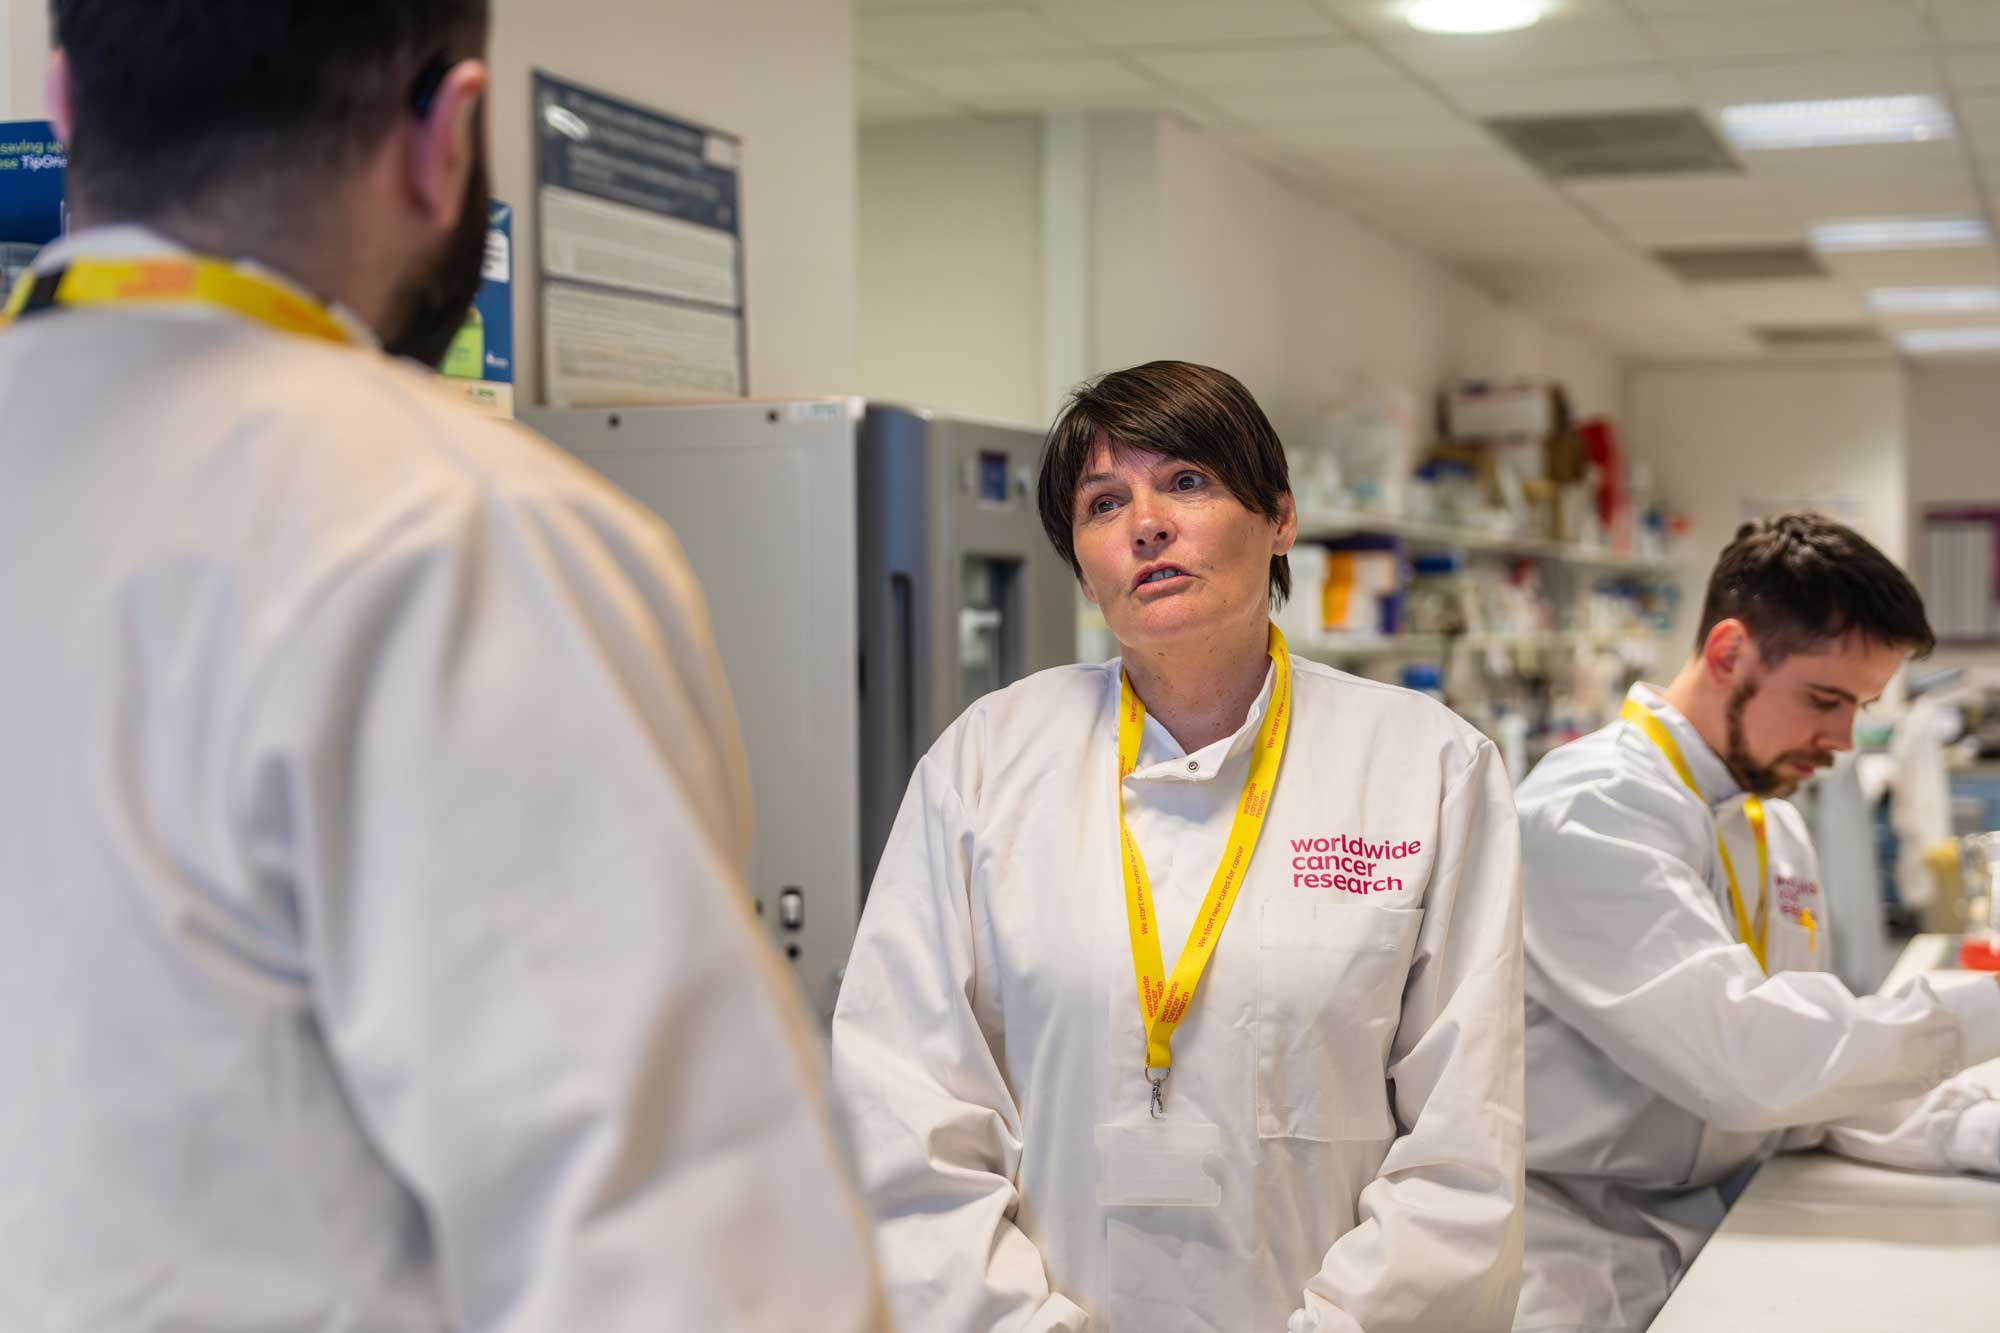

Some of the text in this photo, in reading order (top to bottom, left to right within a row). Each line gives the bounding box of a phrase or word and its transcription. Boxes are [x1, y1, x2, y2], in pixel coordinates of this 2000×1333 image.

[1266, 735, 1275, 749] We
[1271, 718, 1281, 737] start
[1244, 782, 1257, 815] worldwide
[1249, 795, 1260, 816] cancer
[1256, 789, 1268, 818] research
[1290, 834, 1422, 860] worldwide
[1292, 855, 1377, 877] cancer
[1293, 873, 1403, 895] research
[1138, 902, 1146, 921] start
[1198, 935, 1209, 948] We
[1204, 917, 1216, 937] start
[1212, 900, 1222, 918] new
[1219, 880, 1231, 901] cures
[1226, 868, 1235, 881] for
[1141, 922, 1149, 935] We
[1143, 975, 1154, 1019] worldwide
[1160, 981, 1179, 1023] worldwide
[1166, 997, 1180, 1023] cancer
[1172, 991, 1190, 1024] research
